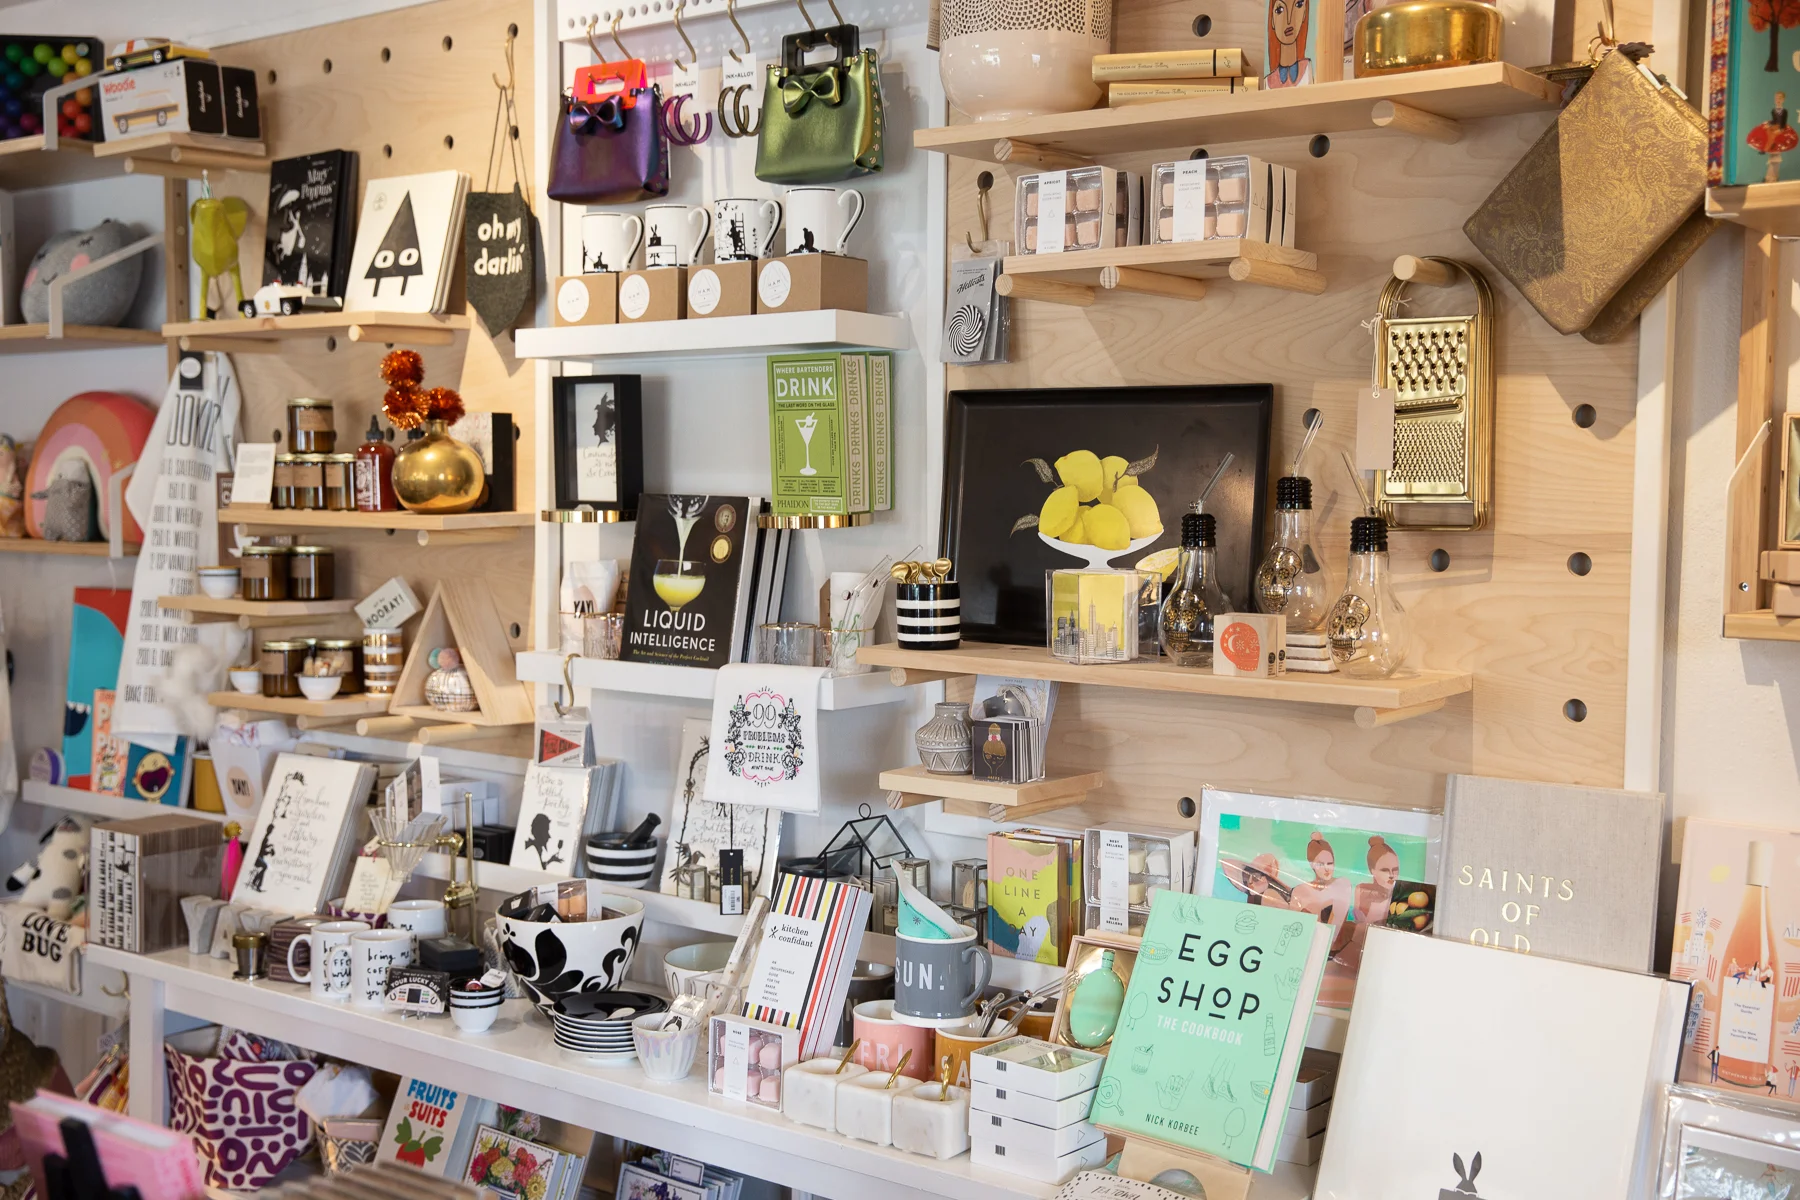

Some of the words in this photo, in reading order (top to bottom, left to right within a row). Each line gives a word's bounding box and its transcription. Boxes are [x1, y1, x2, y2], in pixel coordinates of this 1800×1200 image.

[103, 76, 136, 94] Woodie
[307, 168, 328, 184] Mary
[477, 212, 504, 242] oh
[506, 217, 522, 244] my
[776, 376, 834, 398] DRINK
[847, 360, 858, 405] DRINKS
[875, 361, 884, 406] DRINKS
[850, 411, 860, 455] DRINKS
[876, 411, 884, 455] DRINKS
[852, 461, 861, 505] DRINKS
[876, 460, 884, 504] DRINKS
[776, 500, 808, 508] PHAIDON
[644, 609, 706, 632] LIQUID
[630, 632, 716, 652] INTELLIGENCE
[752, 704, 776, 728] 99
[743, 730, 786, 743] PROBLEMS
[748, 752, 780, 764] DRINK
[1006, 866, 1038, 880] ONE
[1458, 864, 1574, 901] SAINTS
[1004, 885, 1040, 900] LINE
[1018, 906, 1026, 917] A
[1502, 902, 1540, 926] OF
[22, 912, 72, 943] LOVE
[782, 924, 809, 936] kitchen
[1008, 924, 1036, 937] DAY
[22, 931, 62, 962] BUG
[778, 935, 814, 948] confidant
[1470, 928, 1531, 954] OLD
[368, 948, 396, 965] bring
[1178, 933, 1264, 973] EGG
[366, 990, 380, 1000] you
[391, 977, 408, 988] YOUR
[409, 976, 429, 986] LUCKY
[429, 982, 441, 992] DAY
[1157, 976, 1260, 1020] SHOP
[1157, 1014, 1178, 1031] THE
[1182, 1020, 1244, 1046] COOKBOOK
[940, 1055, 970, 1088] SA
[407, 1078, 458, 1110] FRUITS
[408, 1100, 448, 1128] SUITS
[1145, 1114, 1164, 1126] NICK
[1168, 1118, 1200, 1136] KORBEE
[1091, 1185, 1110, 1196] TEA
[1112, 1186, 1141, 1200] TOWEL
